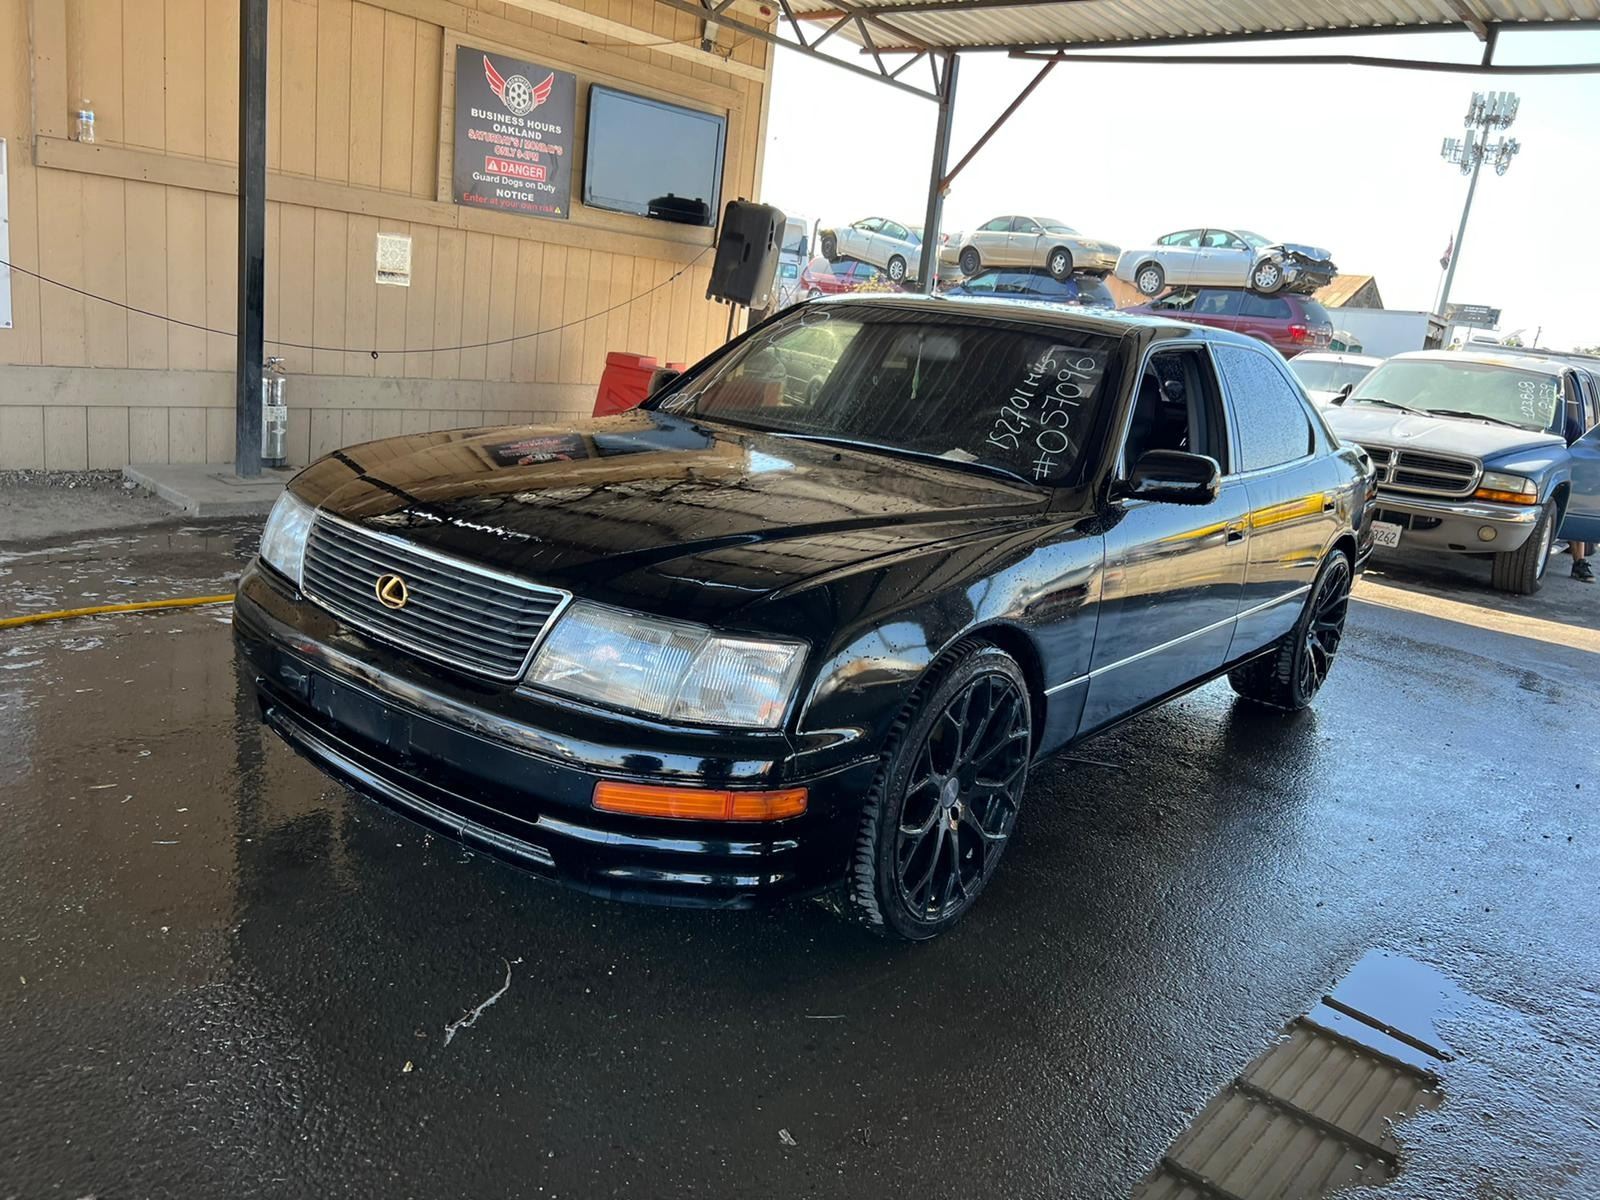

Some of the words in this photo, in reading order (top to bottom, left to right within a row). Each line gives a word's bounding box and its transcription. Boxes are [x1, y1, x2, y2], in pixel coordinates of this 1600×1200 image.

[471, 108, 524, 126] BUSINESS
[527, 120, 562, 134] HOURS
[493, 124, 542, 140] OAKLAND
[494, 145, 516, 158] ONLY
[501, 162, 543, 178] DANGER
[472, 172, 499, 183] Guard
[502, 177, 523, 188] Dogs
[525, 181, 535, 189] on
[538, 183, 556, 194] Duty
[463, 193, 488, 204] Enter
[489, 197, 499, 205] at
[500, 200, 520, 209] your
[521, 203, 538, 211] own
[540, 204, 554, 213] risk
[496, 189, 534, 201] NOTICE
[1033, 357, 1095, 480] #057096
